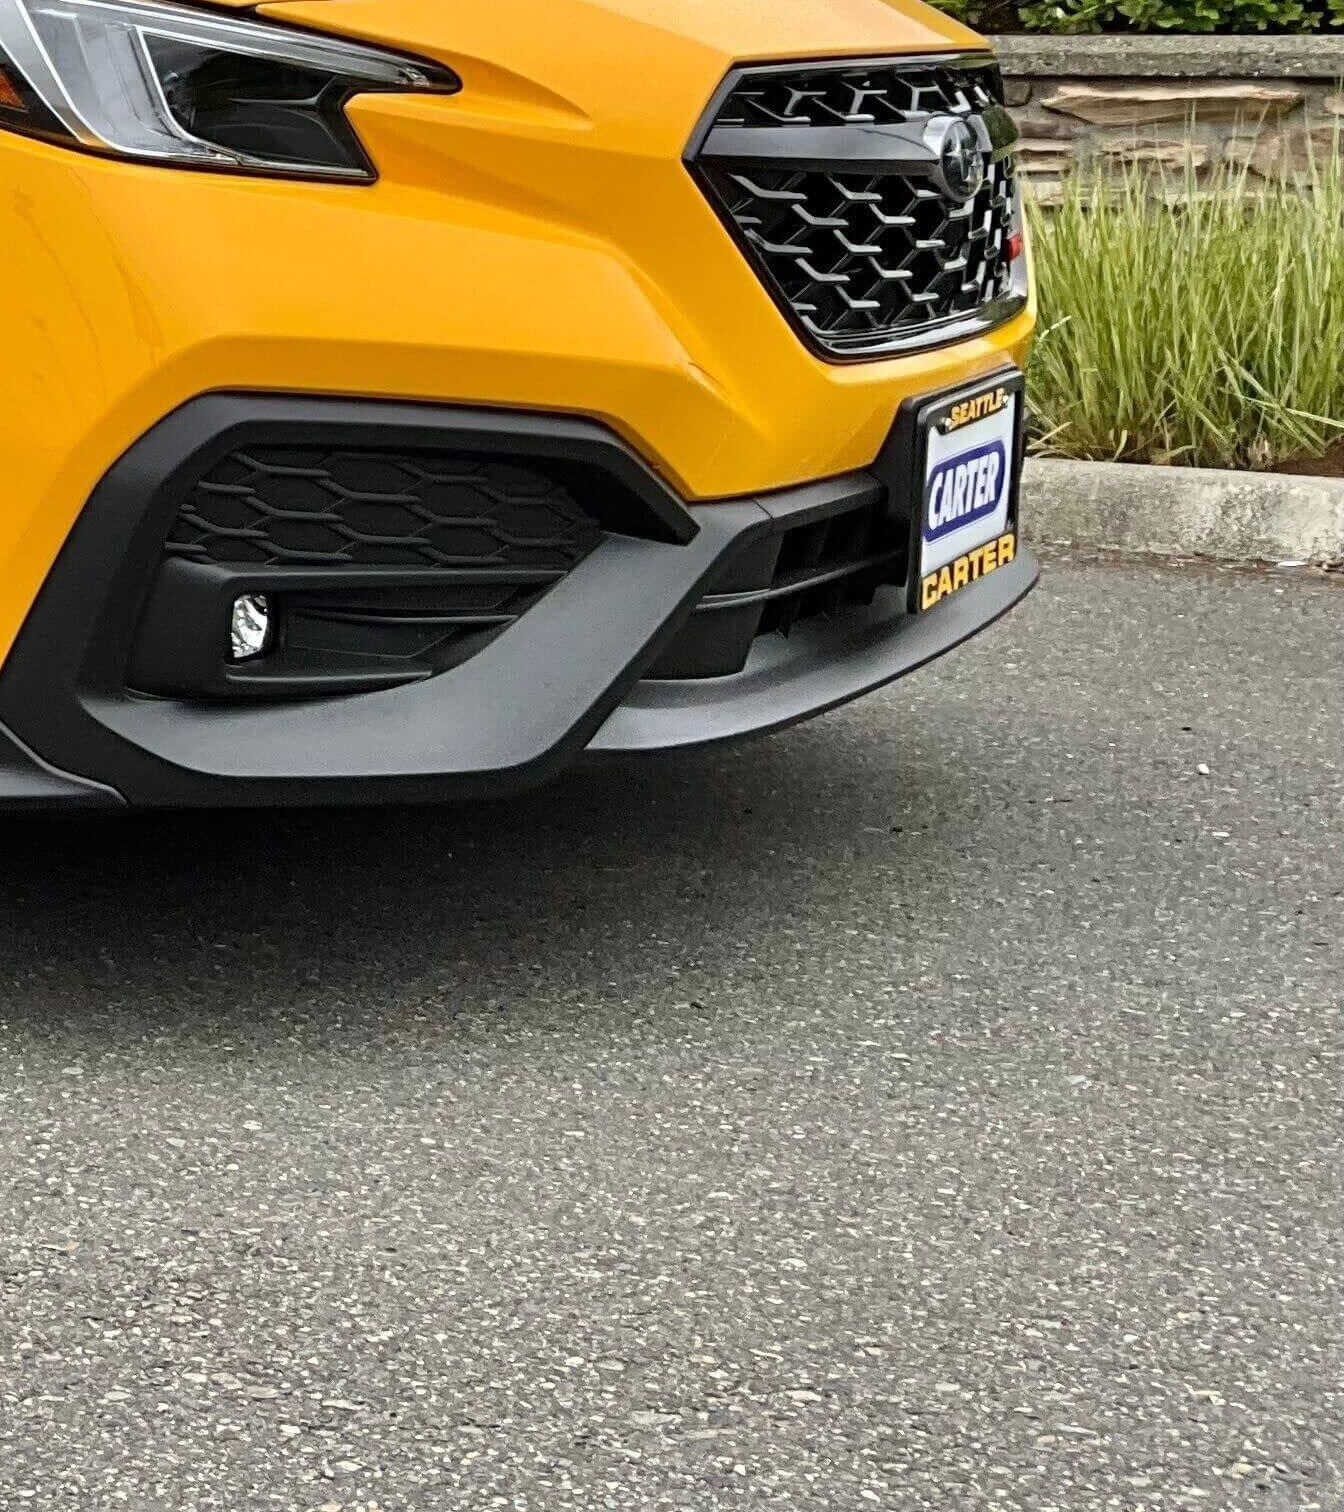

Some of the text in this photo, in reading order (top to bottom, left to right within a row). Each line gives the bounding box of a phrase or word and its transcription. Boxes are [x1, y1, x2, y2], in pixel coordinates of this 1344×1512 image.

[949, 388, 1005, 430] SEATTLE
[928, 451, 1000, 530] CARTER
[921, 534, 1015, 611] CARTER
